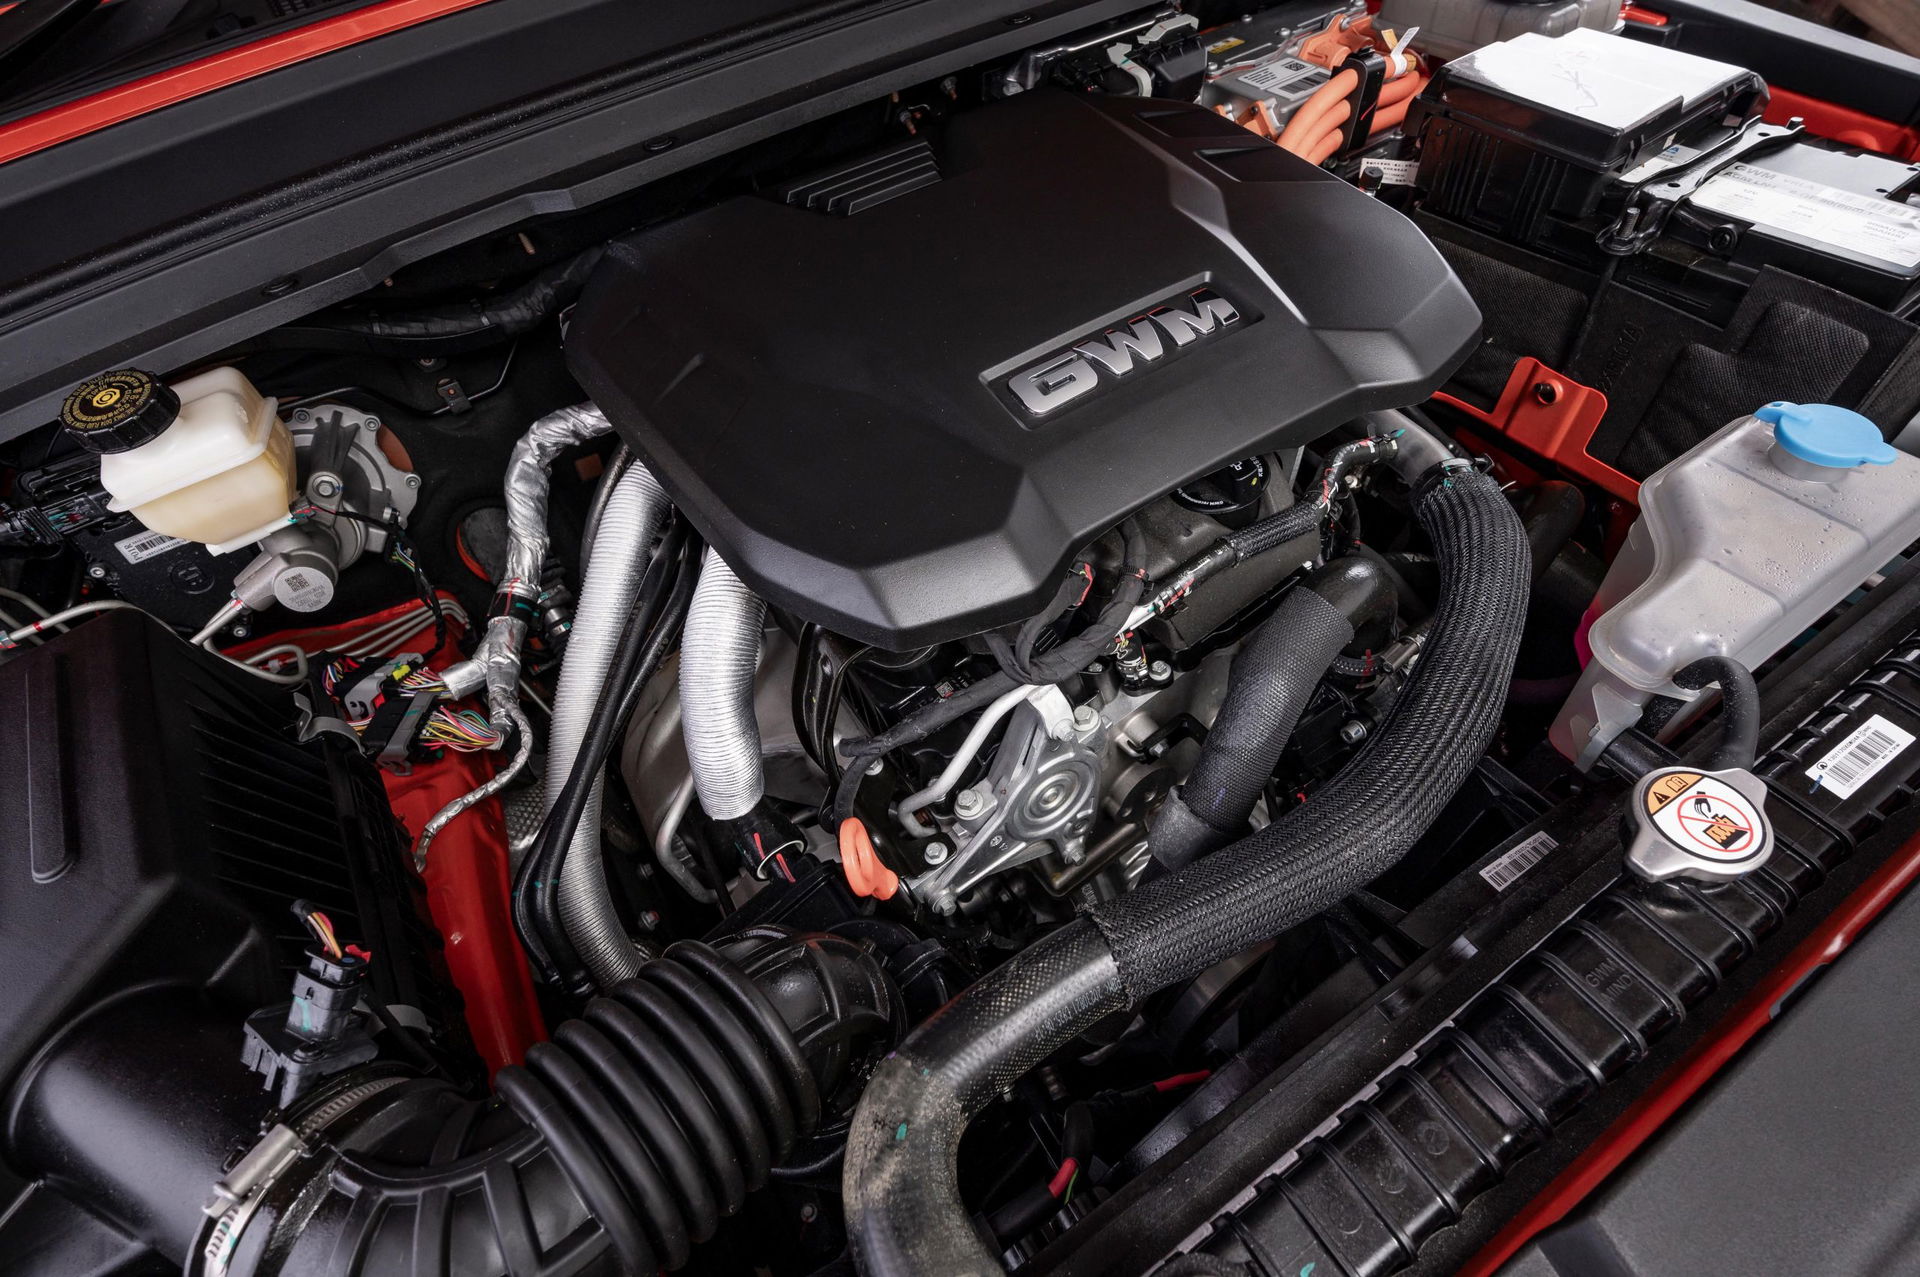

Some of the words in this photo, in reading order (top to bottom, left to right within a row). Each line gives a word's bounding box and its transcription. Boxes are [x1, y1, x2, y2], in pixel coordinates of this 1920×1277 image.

[1734, 165, 1776, 180] GWM
[1007, 287, 1240, 416] GWM
[1585, 957, 1619, 988] GWM
